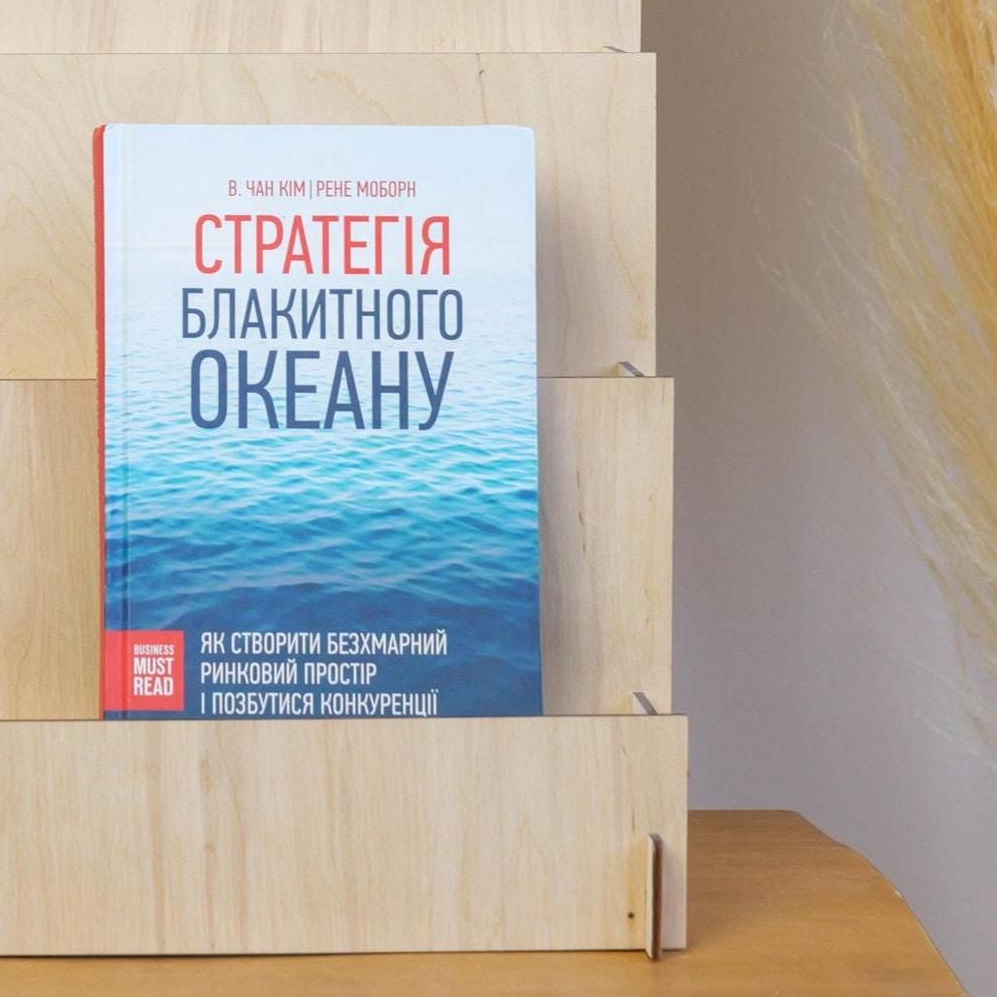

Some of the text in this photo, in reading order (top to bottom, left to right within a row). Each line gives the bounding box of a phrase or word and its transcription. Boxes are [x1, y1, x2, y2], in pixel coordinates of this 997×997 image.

[228, 179, 241, 197] В.
[246, 180, 274, 197] ЧАН
[357, 180, 416, 198] МОБОРН
[194, 213, 451, 275] СТРАТЕГІЯ
[181, 287, 464, 340] БЛАКИТНОГО
[190, 349, 455, 430] ОКЕАНУ
[133, 644, 174, 655] BUSINESS
[200, 629, 447, 655] ЯК СТВОРИТИ БЕЗХМАРНИЙ
[133, 657, 174, 675] MUST
[200, 658, 377, 685] РИНКОВИЙ ПРОСТІР
[133, 676, 174, 696] READ
[200, 688, 439, 717] І ПОЗБУТИСЯ КОНКУРЕНЦІЇ
